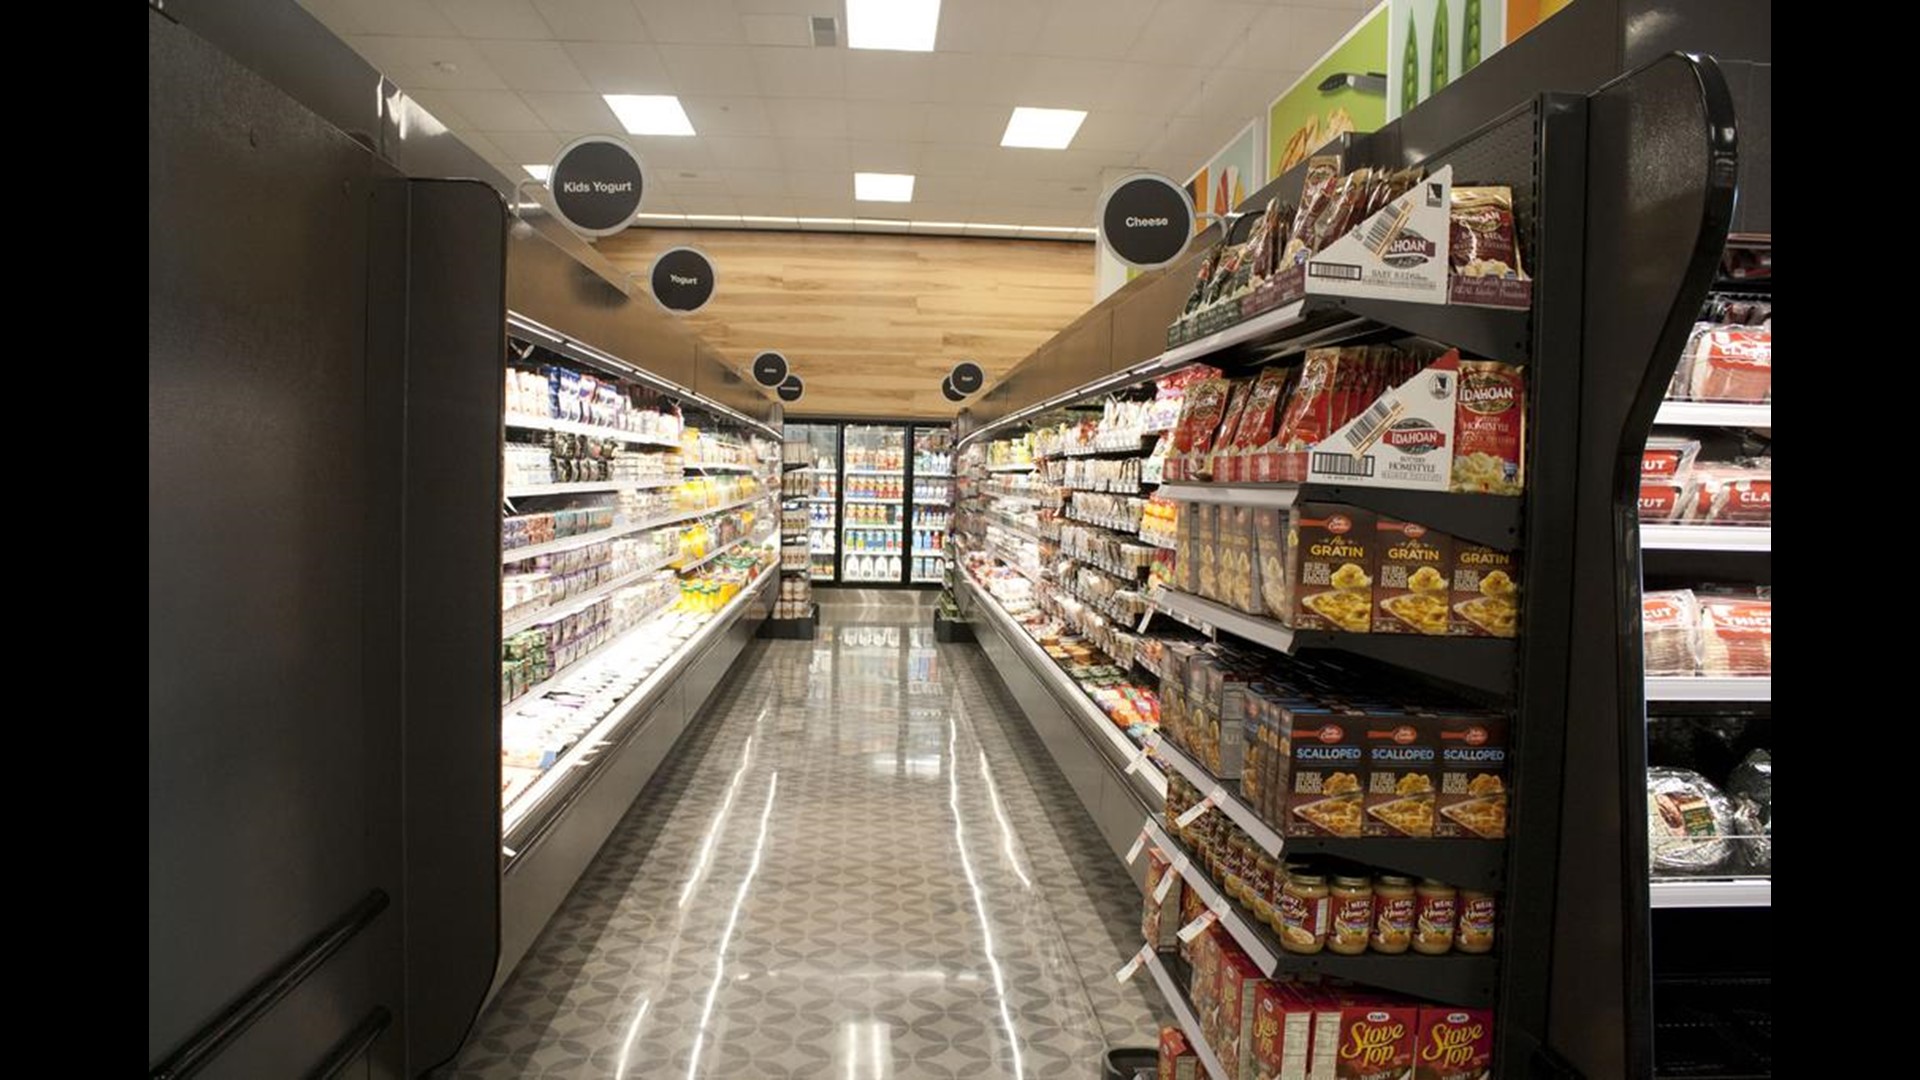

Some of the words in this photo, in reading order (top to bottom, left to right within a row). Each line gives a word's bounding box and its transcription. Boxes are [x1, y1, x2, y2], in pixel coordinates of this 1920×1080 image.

[564, 182, 590, 192] Kids
[593, 181, 632, 193] Yogurt
[1125, 216, 1168, 228] Cheese
[1389, 241, 1427, 252] AHOAN
[669, 274, 698, 285] Yogurt
[1459, 387, 1514, 402] IDAHOAN
[1391, 431, 1438, 444] IDAHOAN
[1310, 544, 1364, 558] GRATIN
[1388, 547, 1440, 560] GRATIN
[1460, 551, 1510, 565] GRATIN
[1296, 748, 1362, 759] SCALLOPED
[1371, 748, 1435, 760] SCALLOPED
[1443, 749, 1505, 761] SCALLOPED
[1341, 1022, 1405, 1059] Stove
[1422, 1023, 1484, 1060] Stove
[1362, 1045, 1394, 1067] Top
[1443, 1046, 1474, 1068] Top
